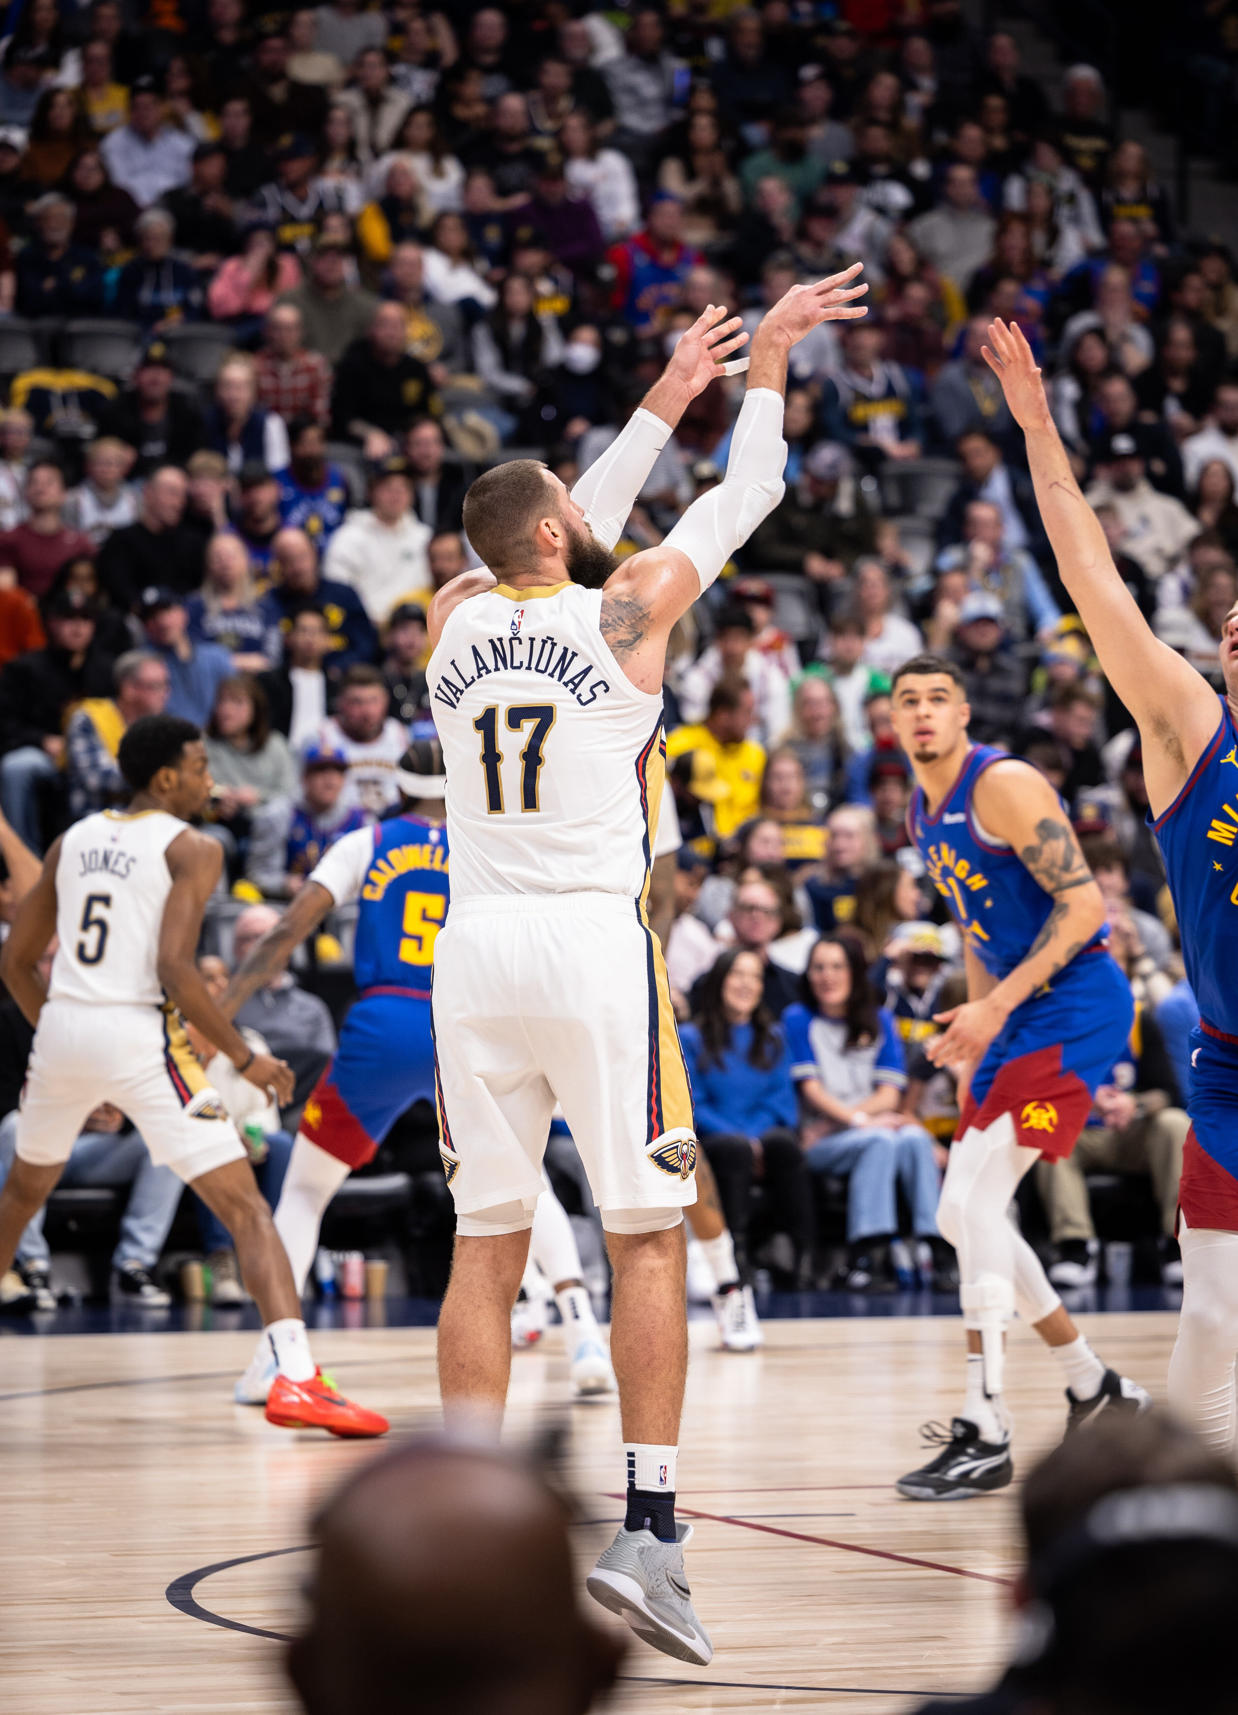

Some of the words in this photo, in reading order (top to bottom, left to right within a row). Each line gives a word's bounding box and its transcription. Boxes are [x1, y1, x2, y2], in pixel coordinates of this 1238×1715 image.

[434, 631, 610, 710] VALANČIŪNAS
[472, 702, 557, 815] 17
[79, 847, 137, 879] JONES
[76, 892, 112, 967] 5
[398, 890, 446, 967] 5
